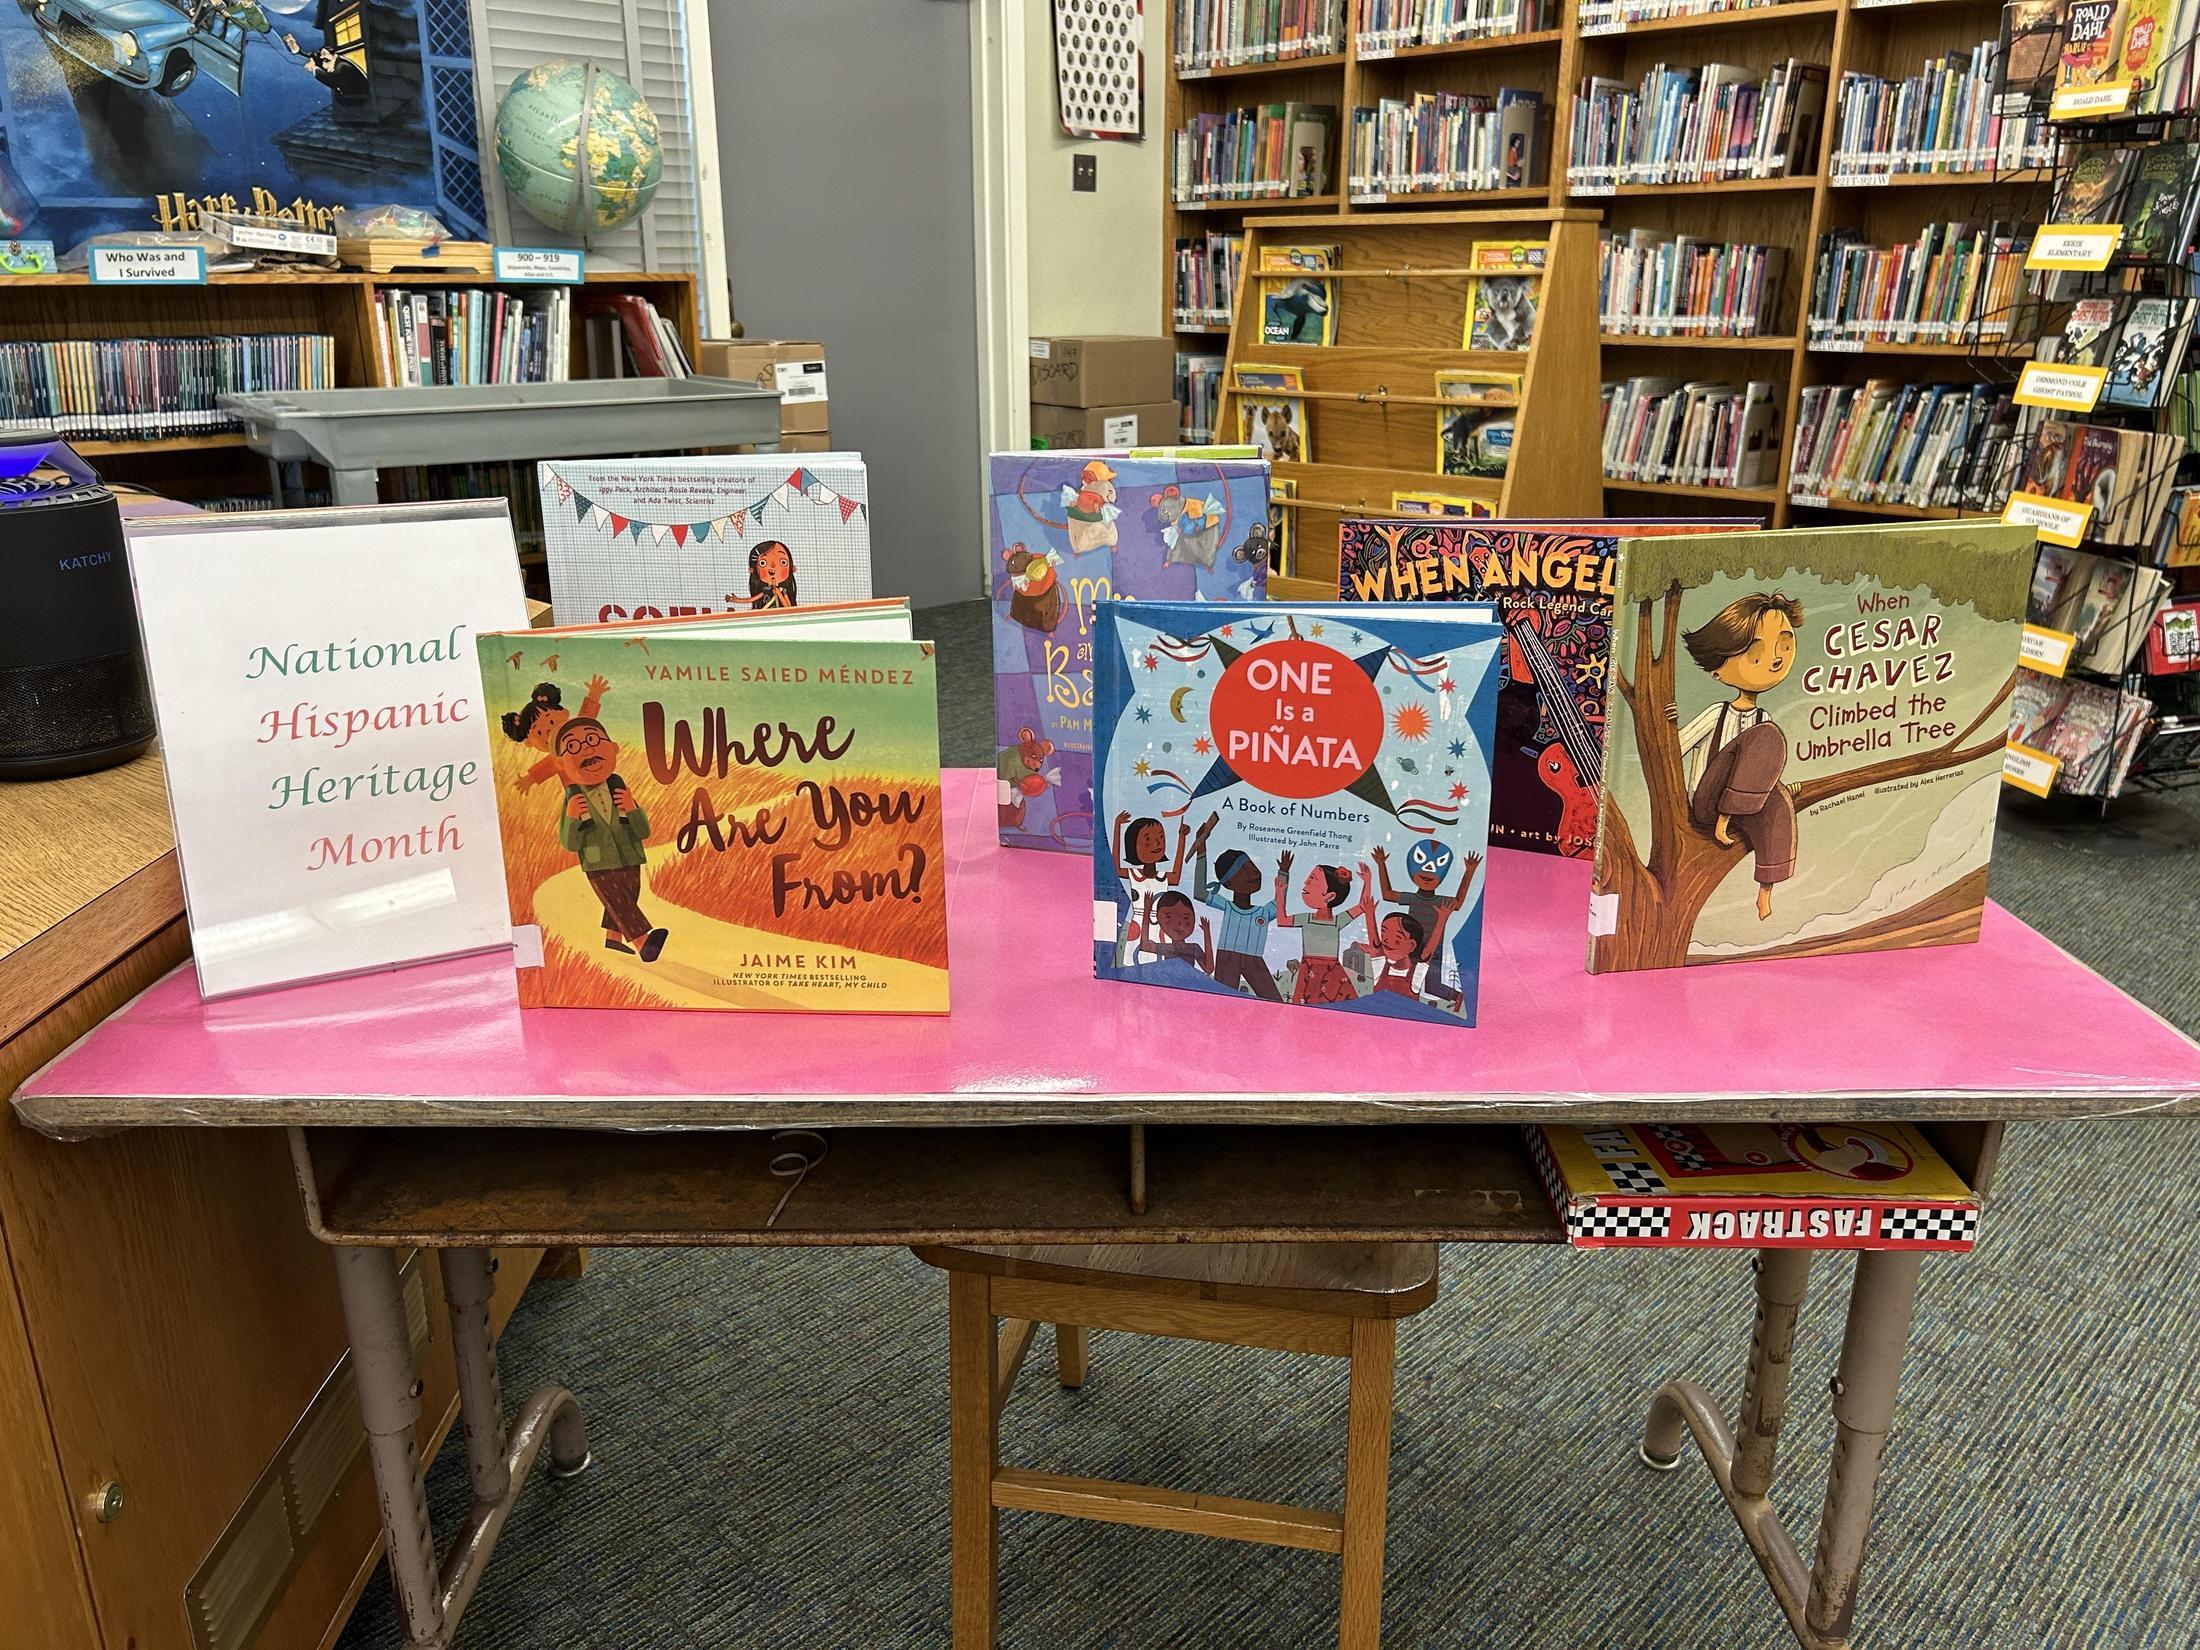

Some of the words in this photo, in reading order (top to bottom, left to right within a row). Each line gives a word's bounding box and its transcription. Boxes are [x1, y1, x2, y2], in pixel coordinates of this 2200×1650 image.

[2073, 4, 2110, 23] ROALD
[2071, 21, 2106, 41] DAHL
[2134, 22, 2153, 35] ROALD
[2130, 33, 2150, 50] DAHL
[2073, 97, 2093, 106] ROALD
[2094, 95, 2113, 104] DAHL
[2047, 249, 2092, 258] ELEMENTARY
[2062, 240, 2083, 248] EERIE
[106, 252, 133, 262] Who
[137, 252, 161, 262] Was
[164, 252, 185, 261] and
[518, 253, 534, 261] 900
[119, 269, 123, 277] I
[127, 267, 175, 278] Survived
[1264, 326, 1289, 335] OCEAN
[2036, 375, 2067, 386] DESMOND
[2069, 379, 2087, 388] COLE
[2033, 387, 2056, 397] GHOST
[2056, 389, 2084, 399] PATROL
[589, 475, 605, 483] From
[607, 475, 619, 483] the
[622, 475, 635, 483] New
[678, 476, 716, 484] bestselling
[717, 488, 747, 496] Engineer,
[2022, 507, 2060, 520] GUARDIANS
[59, 550, 112, 571] KATCHY
[1350, 554, 1471, 601] WHEN
[1483, 546, 1615, 595] ANGEL
[1503, 597, 1535, 610] Rock
[1540, 597, 1586, 615] Legend
[1589, 602, 1613, 617] Car
[1857, 593, 1910, 615] When
[1611, 629, 1619, 654] When
[1825, 614, 1942, 657] CESAR
[245, 624, 467, 680] National
[645, 665, 730, 682] YAMILE
[741, 667, 808, 683] SAIED
[818, 663, 914, 685] MÉNDEZ
[1247, 659, 1333, 695] ONE
[1802, 651, 1955, 694] CHAVEZ
[256, 692, 469, 749] Hispanic
[1276, 699, 1294, 721] Is
[1302, 706, 1314, 723] a
[1809, 695, 1896, 731] Climbed
[1908, 692, 1946, 716] the
[1060, 715, 1080, 731] PAM
[1083, 718, 1093, 732] M
[642, 701, 855, 785] Where
[1228, 724, 1362, 770] PIÑATA
[1796, 728, 1892, 762] Umbrella
[1900, 720, 1956, 744] Tree
[1601, 750, 1609, 783] Climbed
[268, 757, 478, 811] Heritage
[1910, 781, 1918, 789] by
[1920, 777, 1934, 786] Alex
[1935, 770, 1964, 782] Herrerias
[1222, 796, 1234, 811] A
[1239, 798, 1276, 815] Book
[1280, 802, 1297, 816] of
[1301, 804, 1370, 823] Numbers
[1810, 809, 1819, 817] by
[1819, 797, 1846, 812] Rachael
[1847, 791, 1865, 802] Hanel
[677, 787, 788, 854] Are
[796, 780, 926, 852] You
[306, 814, 464, 872] Month
[1237, 822, 1247, 832] By
[1249, 823, 1285, 834] Roseanne
[1287, 826, 1326, 838] Greenfield
[1329, 831, 1353, 843] Thong
[1248, 834, 1286, 845] Illustrated
[1288, 837, 1297, 847] by
[1299, 839, 1317, 848] John
[1319, 841, 1340, 850] Parra
[1490, 823, 1505, 835] IN
[1520, 830, 1540, 840] art
[1545, 831, 1560, 845] by
[1566, 834, 1593, 847] JOS
[771, 843, 926, 918] From?
[740, 953, 805, 968] JAIME
[816, 955, 857, 969] KIM
[713, 979, 771, 987] ILLUSTRATOR
[787, 980, 809, 988] TAKE
[812, 981, 842, 989] HEART,
[755, 972, 778, 980] YORK
[1583, 1124, 1640, 1158] FA
[1687, 1207, 1873, 1241] FASTRACK
